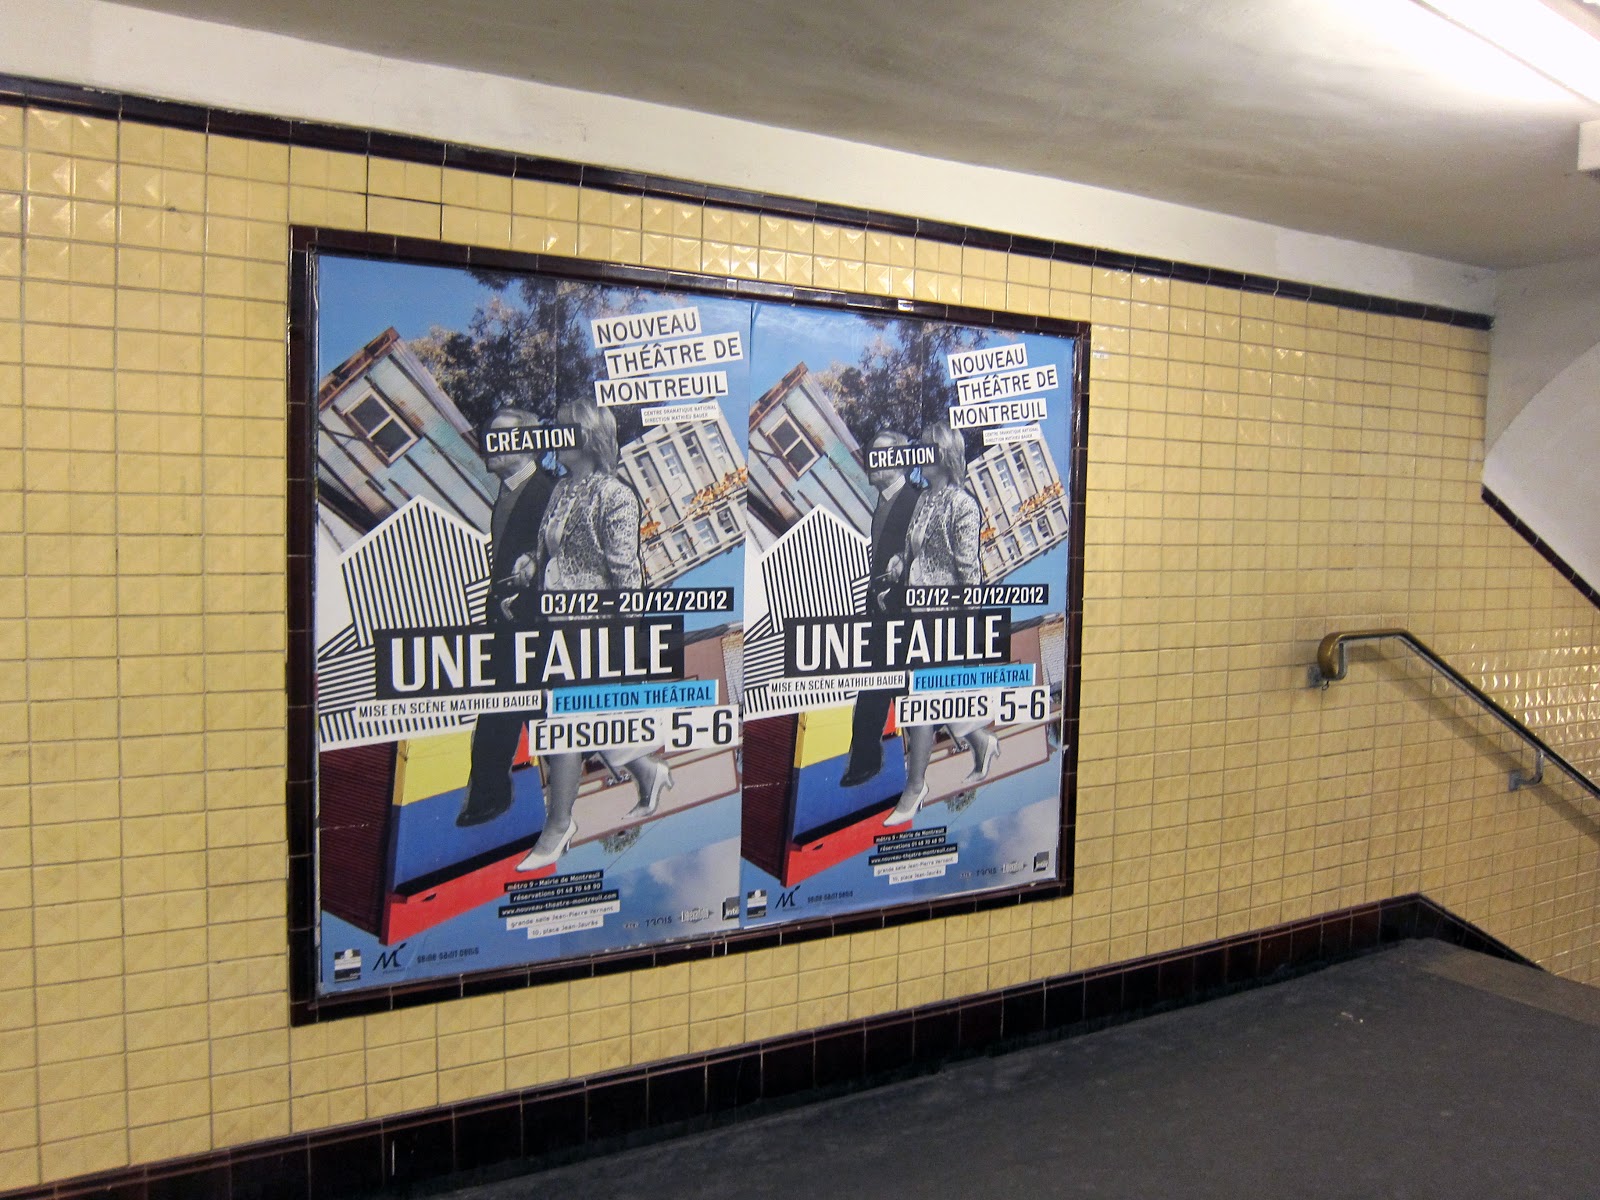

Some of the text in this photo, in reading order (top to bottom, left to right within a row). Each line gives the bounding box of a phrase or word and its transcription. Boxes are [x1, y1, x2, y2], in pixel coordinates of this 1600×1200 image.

[597, 312, 697, 344] NOUVEAU
[607, 337, 740, 374] THÉÂTRE DE
[951, 348, 1025, 375] NOUVEAU
[599, 375, 726, 403] MONTREUIL
[959, 369, 1056, 401] THÉÂTRE DE
[953, 401, 1046, 426] MONTREUIL
[485, 428, 576, 452] CRÉATION
[868, 447, 935, 468] CRÉATION
[540, 592, 598, 614] 03/12
[619, 590, 728, 612] 20/12/2012
[905, 588, 949, 607] 03/12
[963, 586, 1044, 606] 20/12/2012
[796, 615, 1003, 671] UNE FAILLE
[391, 623, 673, 692] UNE FAILLE
[771, 674, 904, 693] MISE EN SCÈNE MATHIEU BAUER
[915, 667, 1031, 690] FEUILLETON THÉÂTRAL
[359, 694, 539, 718] MISE EN SCÈNE MATHIEU BAUER
[555, 684, 713, 713] FEUILLETON THÉÂTRAL
[900, 689, 1046, 723] ÉPISODES 5-6
[535, 708, 733, 751] ÉPISODES 5-6
